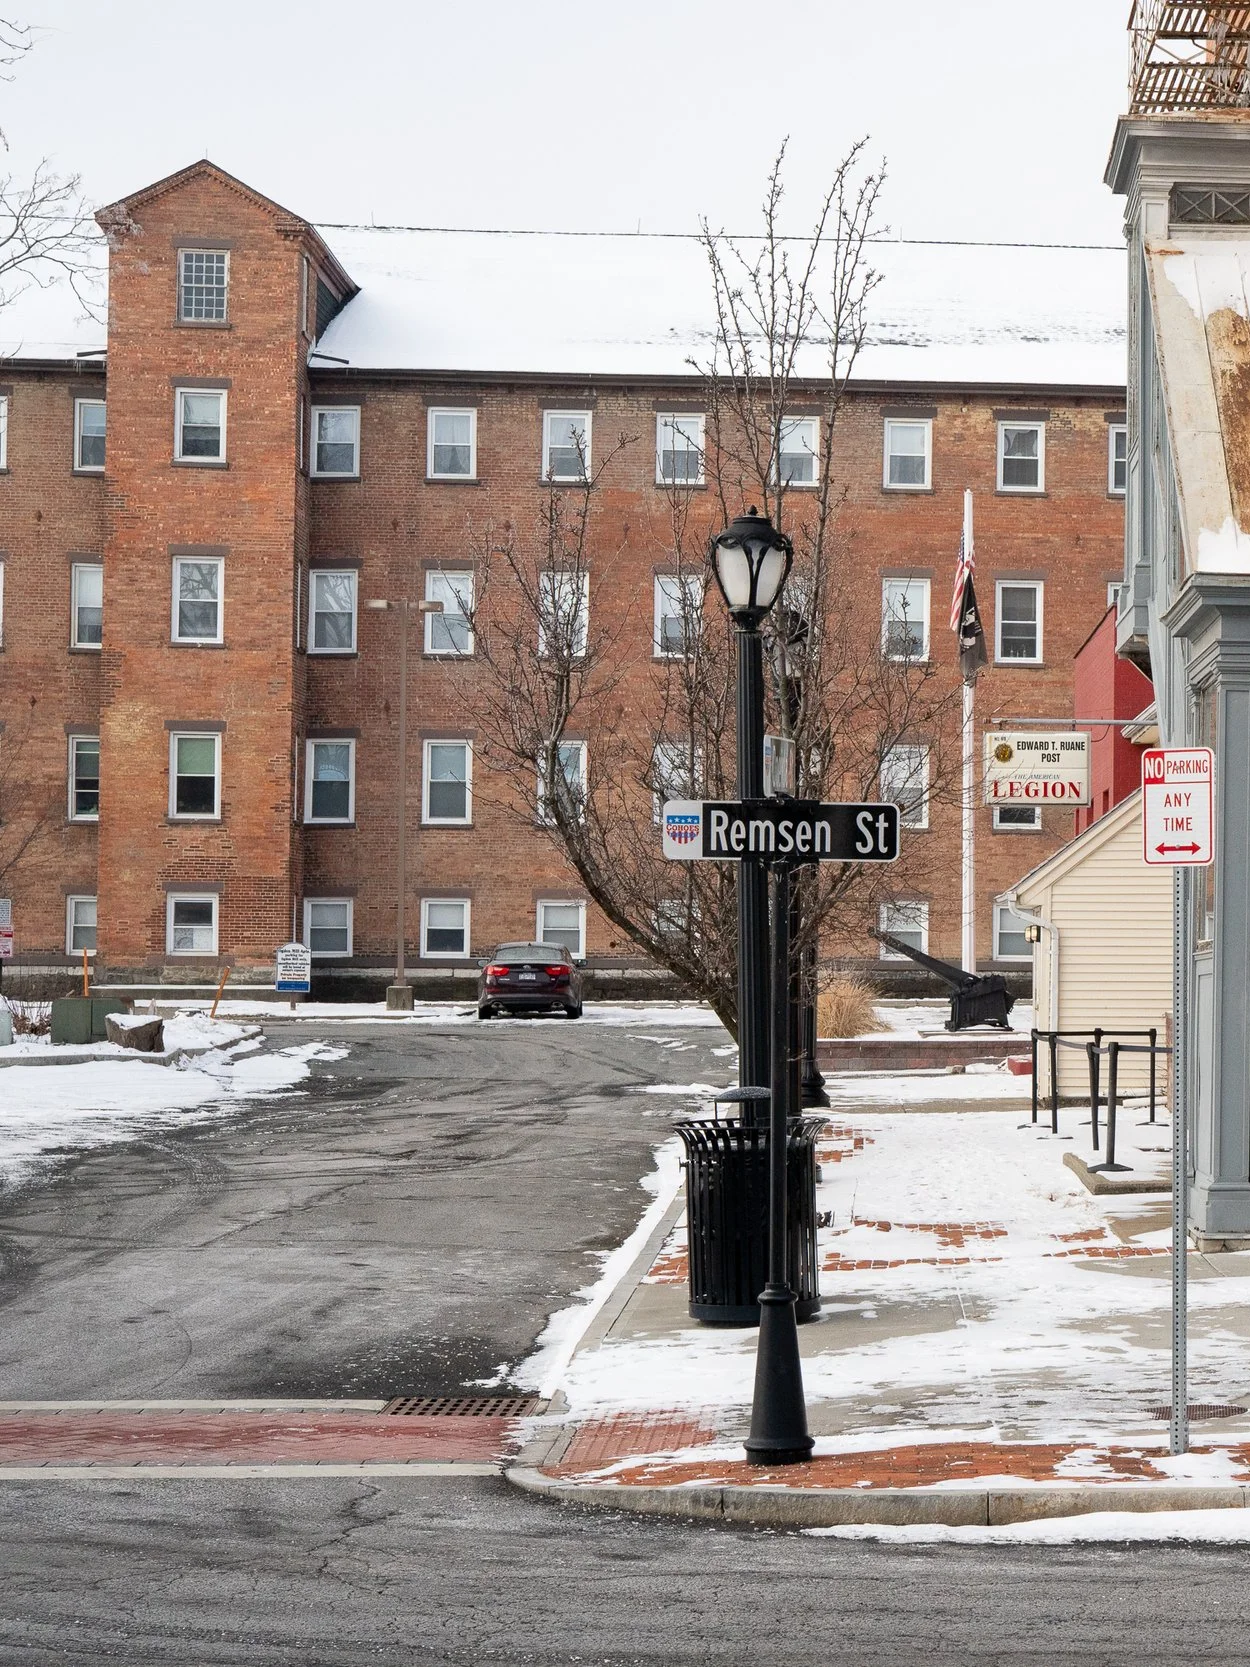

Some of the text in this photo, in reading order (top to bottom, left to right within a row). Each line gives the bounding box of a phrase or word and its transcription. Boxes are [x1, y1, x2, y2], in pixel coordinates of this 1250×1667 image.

[1016, 741, 1086, 751] EDWARD T. RUANE
[1041, 753, 1061, 763] POST
[1145, 757, 1209, 779] NO PARKING
[992, 780, 1082, 799] LEGION
[1164, 793, 1192, 808] ANY
[710, 810, 889, 854] Remsen St
[1163, 817, 1193, 832] TIME
